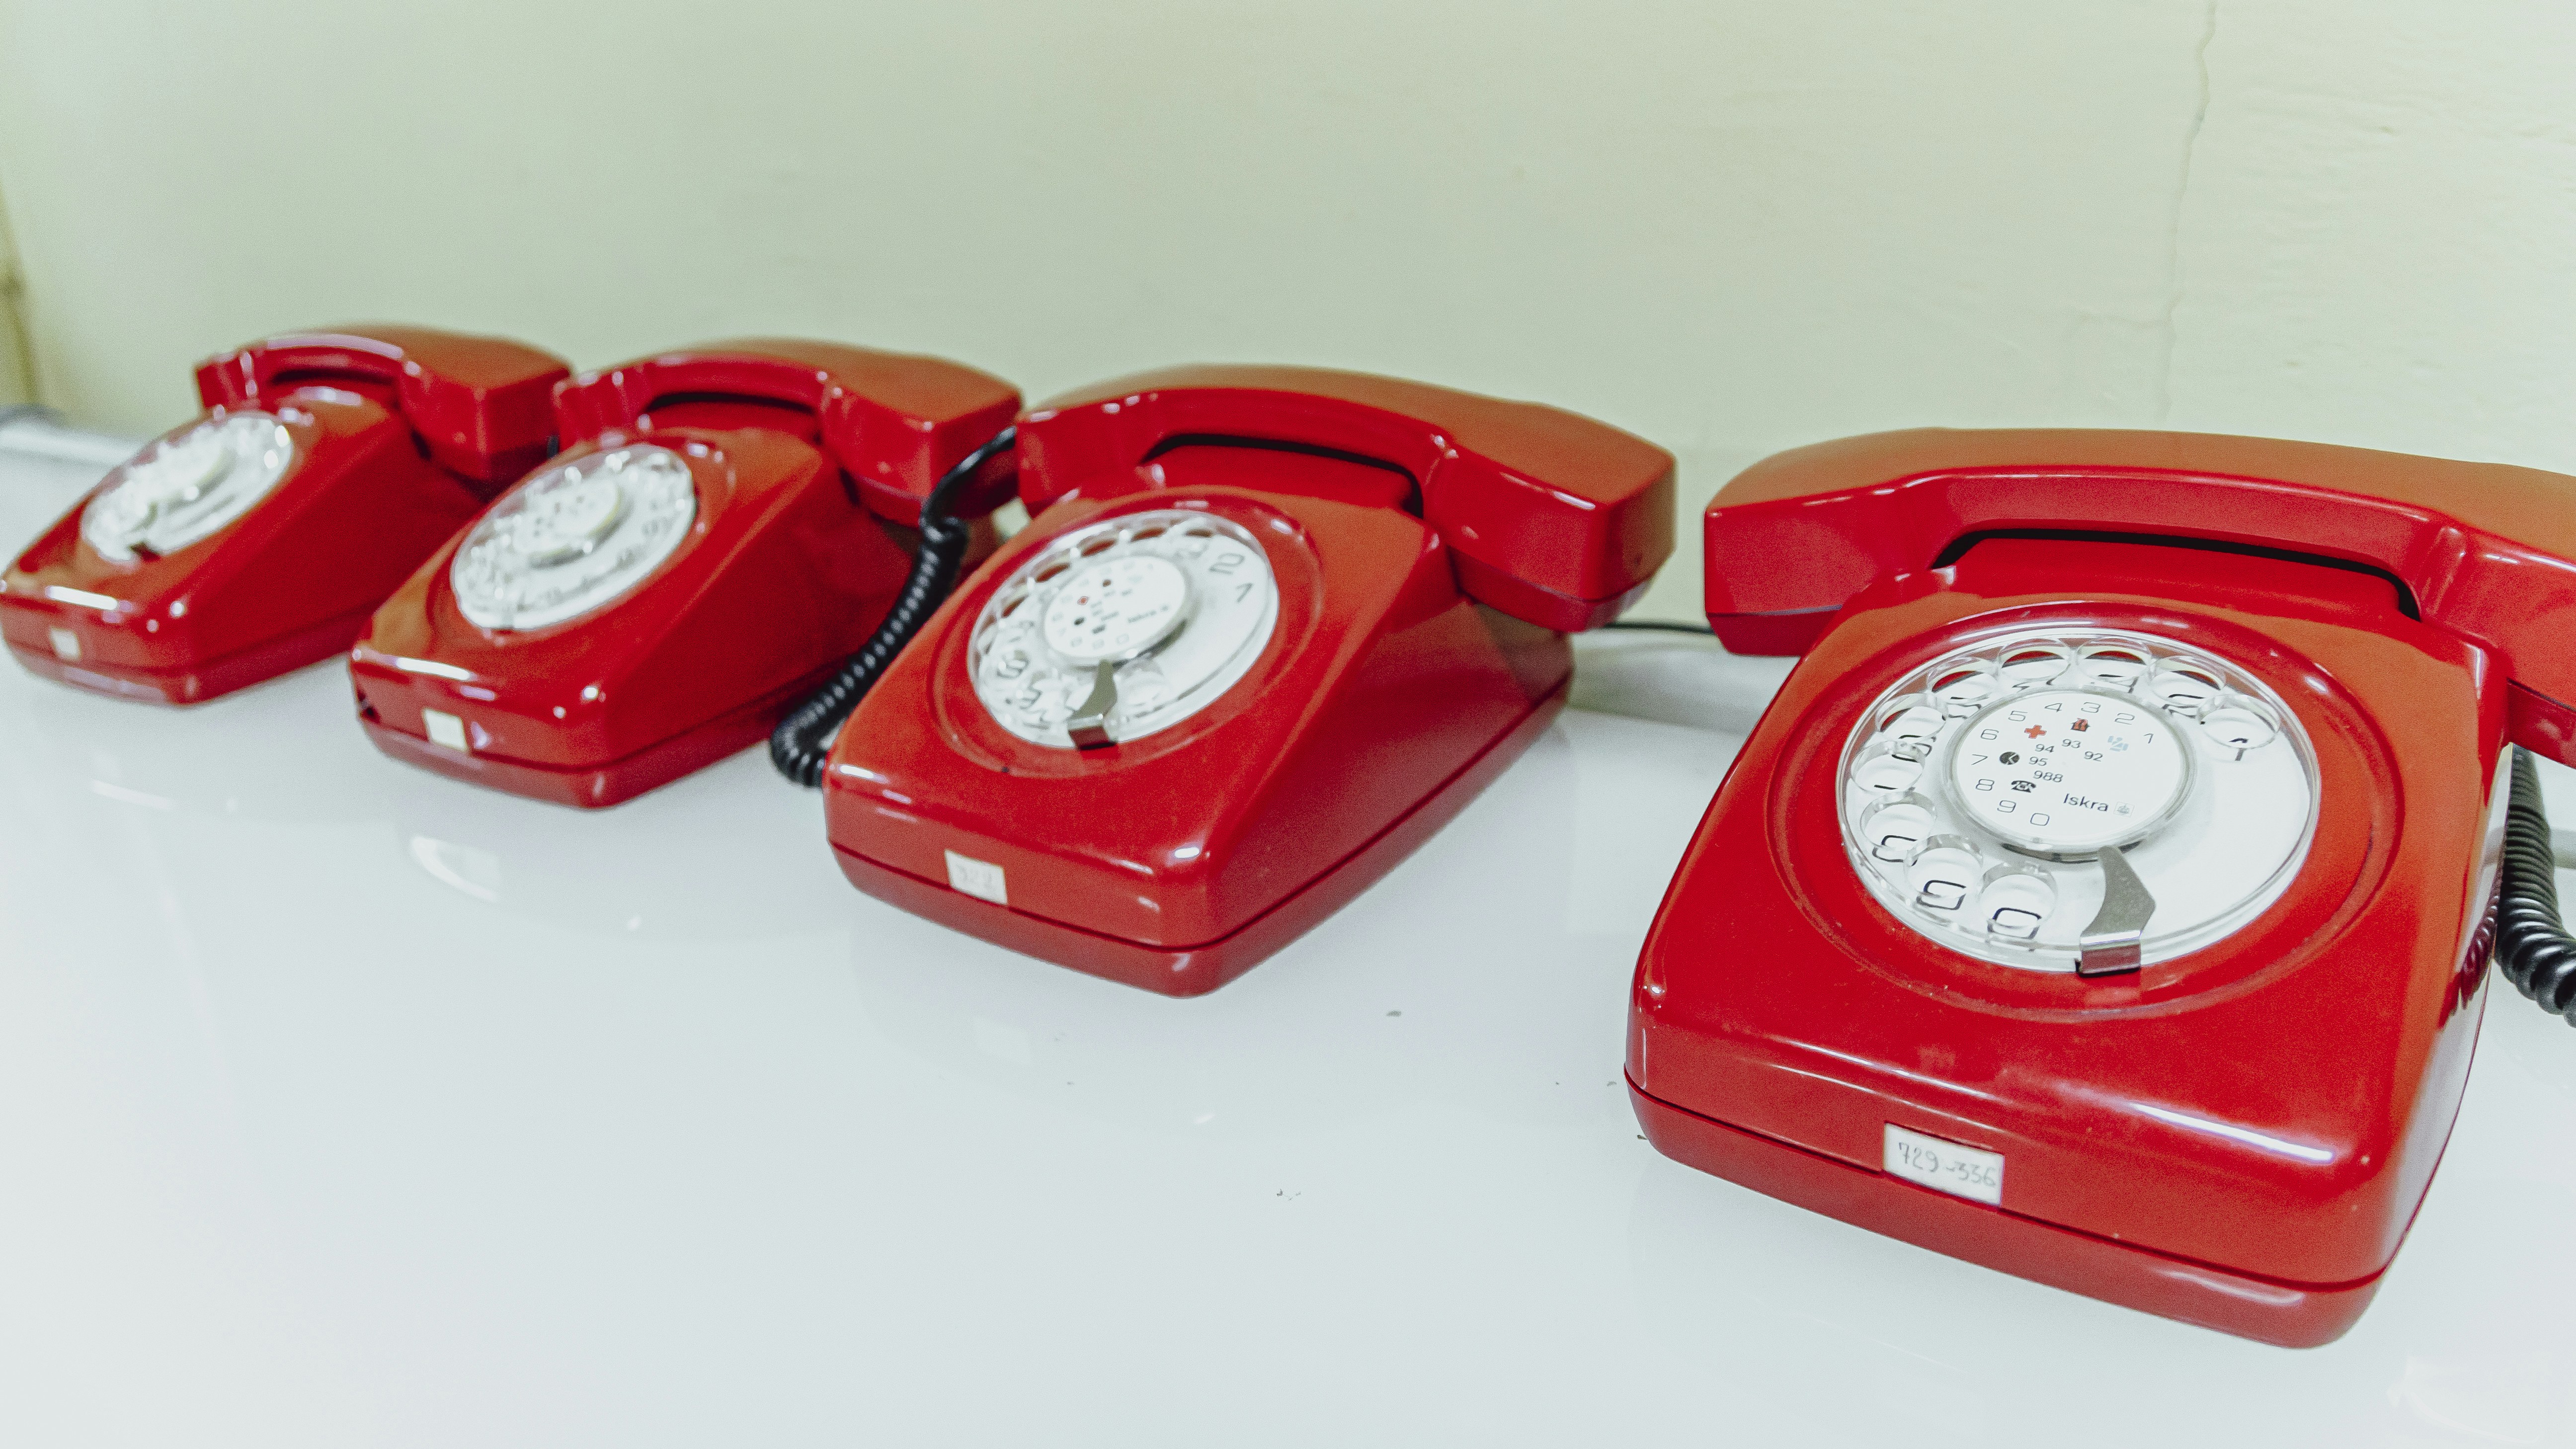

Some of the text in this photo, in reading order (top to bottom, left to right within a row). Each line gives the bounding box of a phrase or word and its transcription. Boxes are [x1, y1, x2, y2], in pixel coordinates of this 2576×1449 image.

[1208, 552, 1245, 575] 2
[2044, 702, 2063, 713] 4
[2081, 702, 2101, 714] 3
[2008, 710, 2028, 722] 5
[2114, 713, 2135, 725] 2
[1980, 728, 2000, 740] 6
[2144, 733, 2154, 744] 1
[2035, 743, 2055, 754] 94
[2061, 738, 2082, 749] 93
[1971, 754, 1989, 766] 7
[2028, 756, 2048, 767] 95
[2084, 750, 2103, 762] 92
[2032, 770, 2064, 783] 988
[1975, 779, 1995, 791] 8
[1997, 800, 2017, 813] 9
[2063, 793, 2109, 812] Iskra
[2029, 812, 2050, 826] 0
